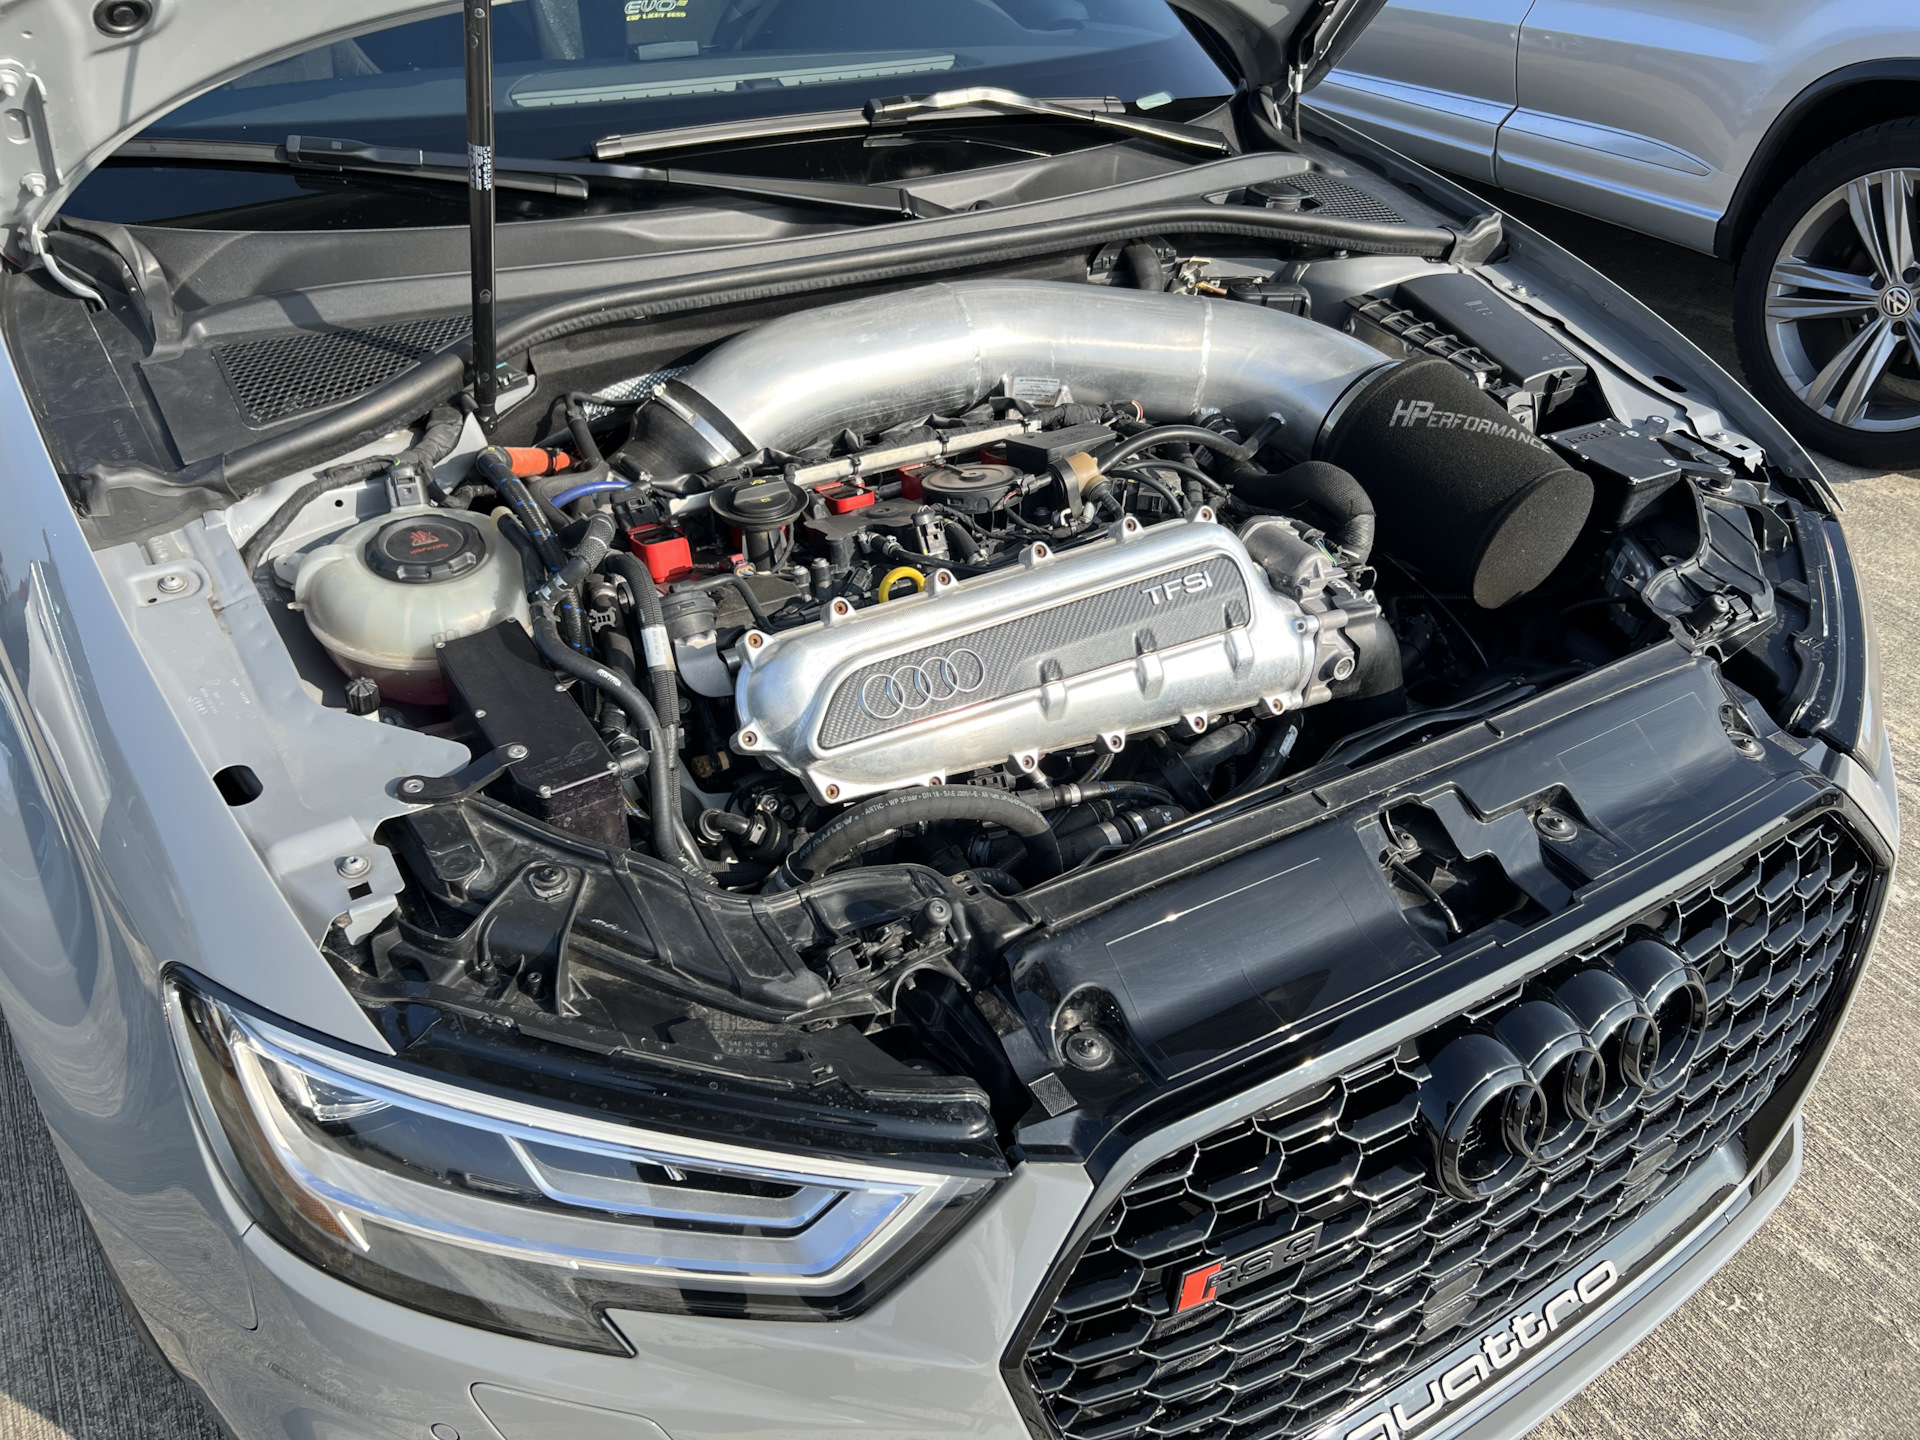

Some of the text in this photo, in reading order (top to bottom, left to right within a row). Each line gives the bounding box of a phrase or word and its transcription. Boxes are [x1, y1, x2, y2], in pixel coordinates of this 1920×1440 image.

[1140, 570, 1213, 605] TFSI
[865, 802, 885, 815] ARTIC
[888, 795, 899, 806] WP
